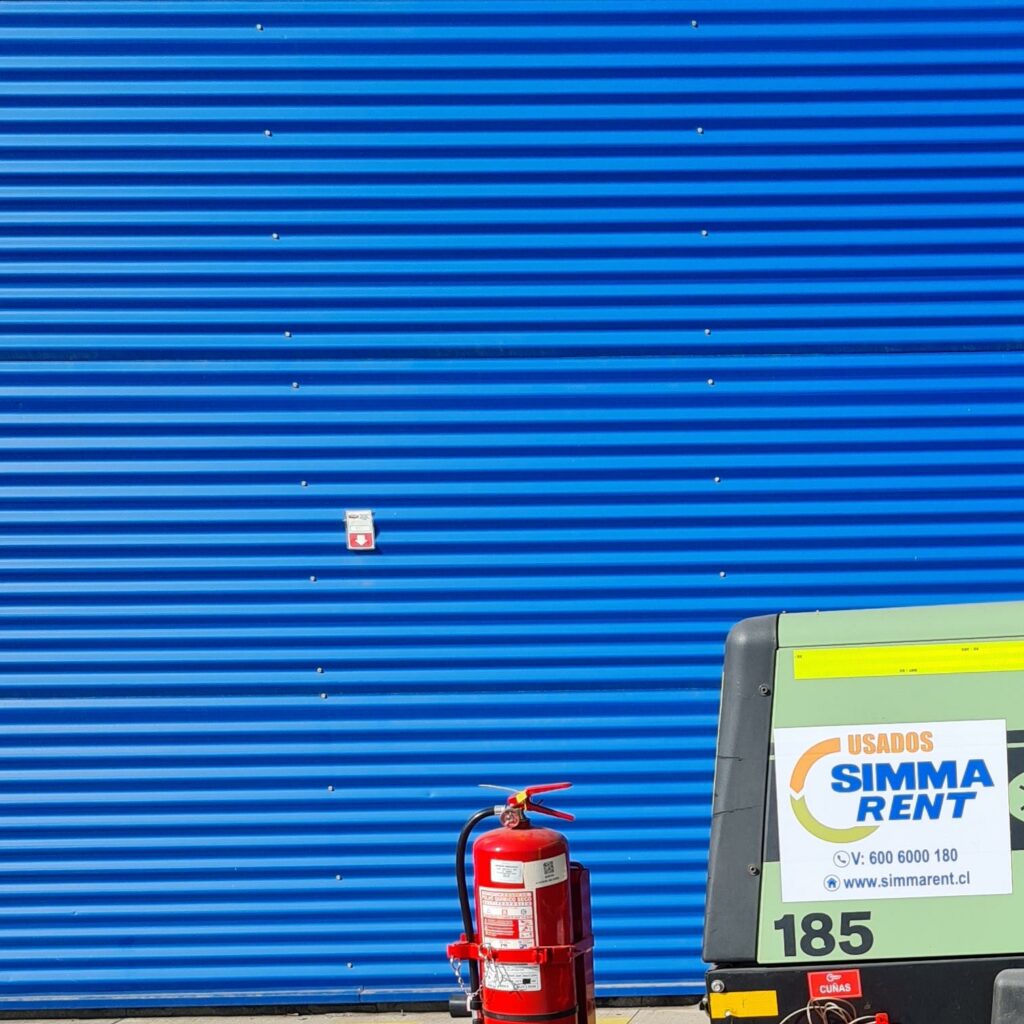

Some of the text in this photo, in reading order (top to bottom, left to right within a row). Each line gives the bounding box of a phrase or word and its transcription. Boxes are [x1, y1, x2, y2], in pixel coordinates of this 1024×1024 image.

[847, 731, 934, 755] USADOS
[831, 759, 995, 793] SIMMA
[856, 791, 977, 822] RENT
[851, 848, 958, 866] V: 600 6000 180
[843, 871, 971, 889] www.simmarent.cl
[774, 911, 875, 957] 185
[819, 982, 851, 994] CUÑAS
